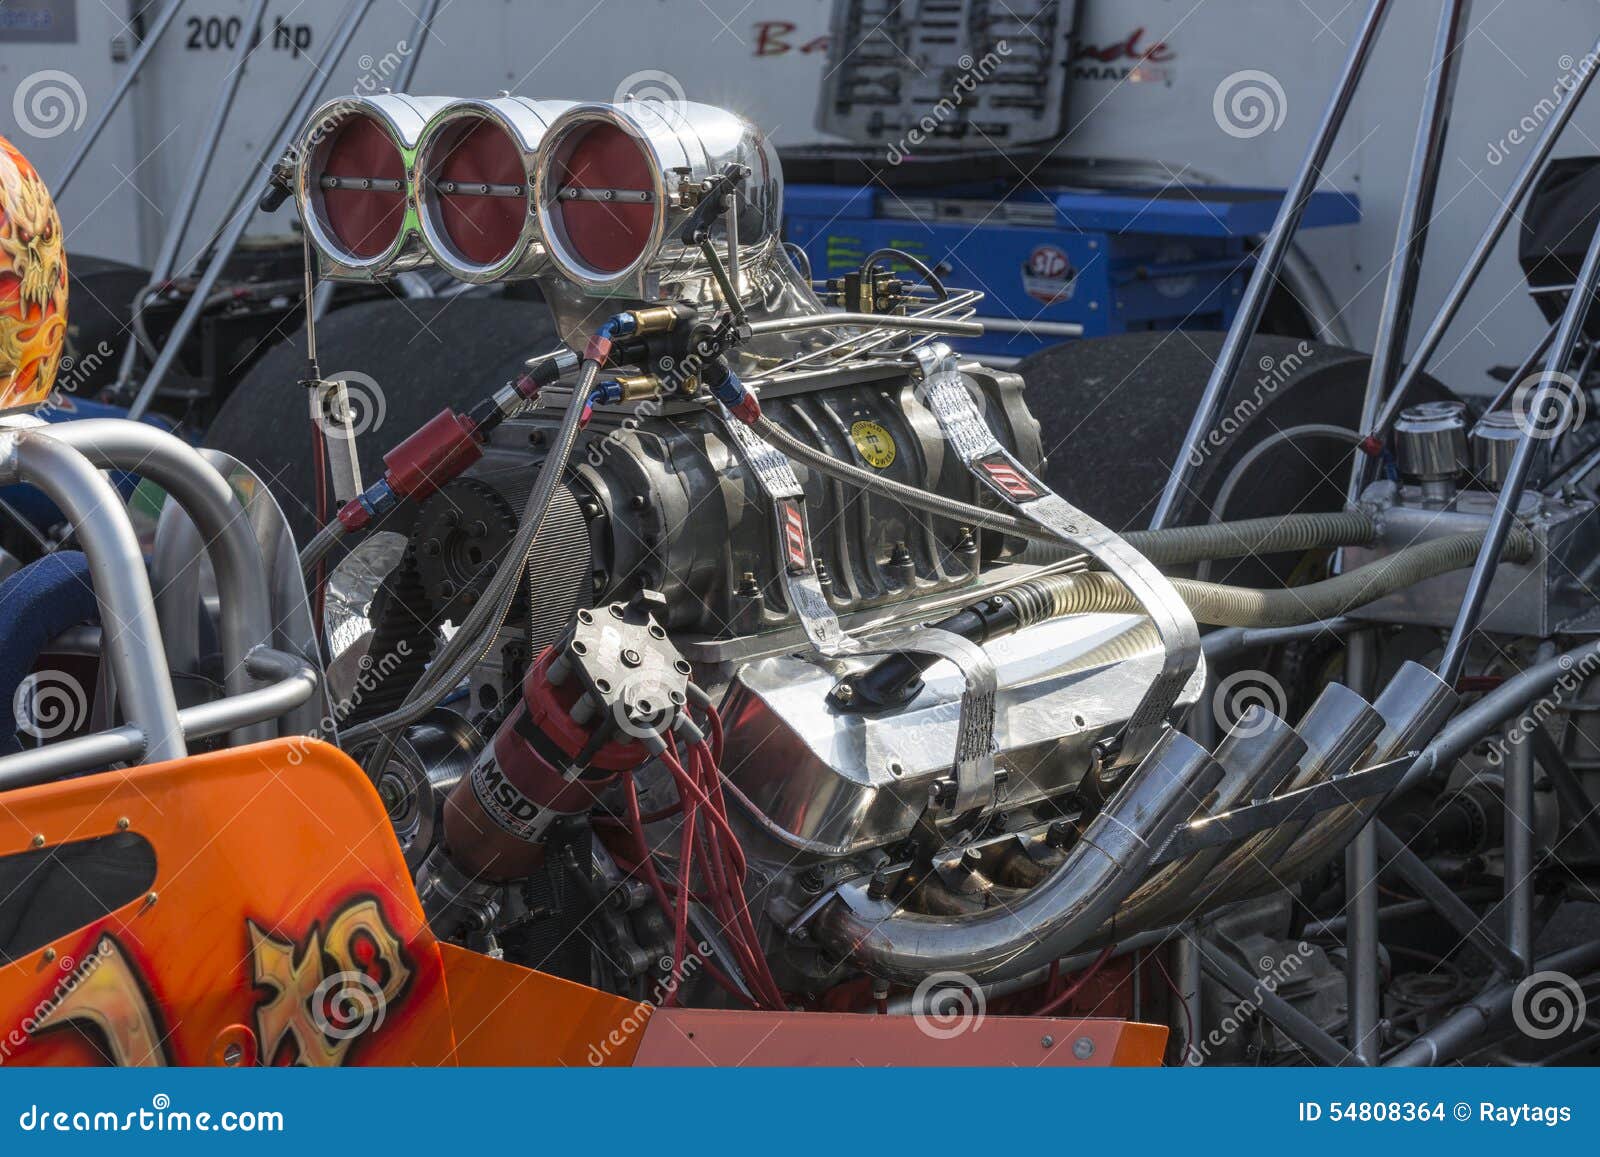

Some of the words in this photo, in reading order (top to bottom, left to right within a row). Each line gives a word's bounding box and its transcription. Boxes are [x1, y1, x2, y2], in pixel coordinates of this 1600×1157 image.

[186, 16, 261, 51] 200
[273, 16, 311, 59] hp
[1034, 252, 1066, 274] STP
[481, 757, 540, 821] MSD
